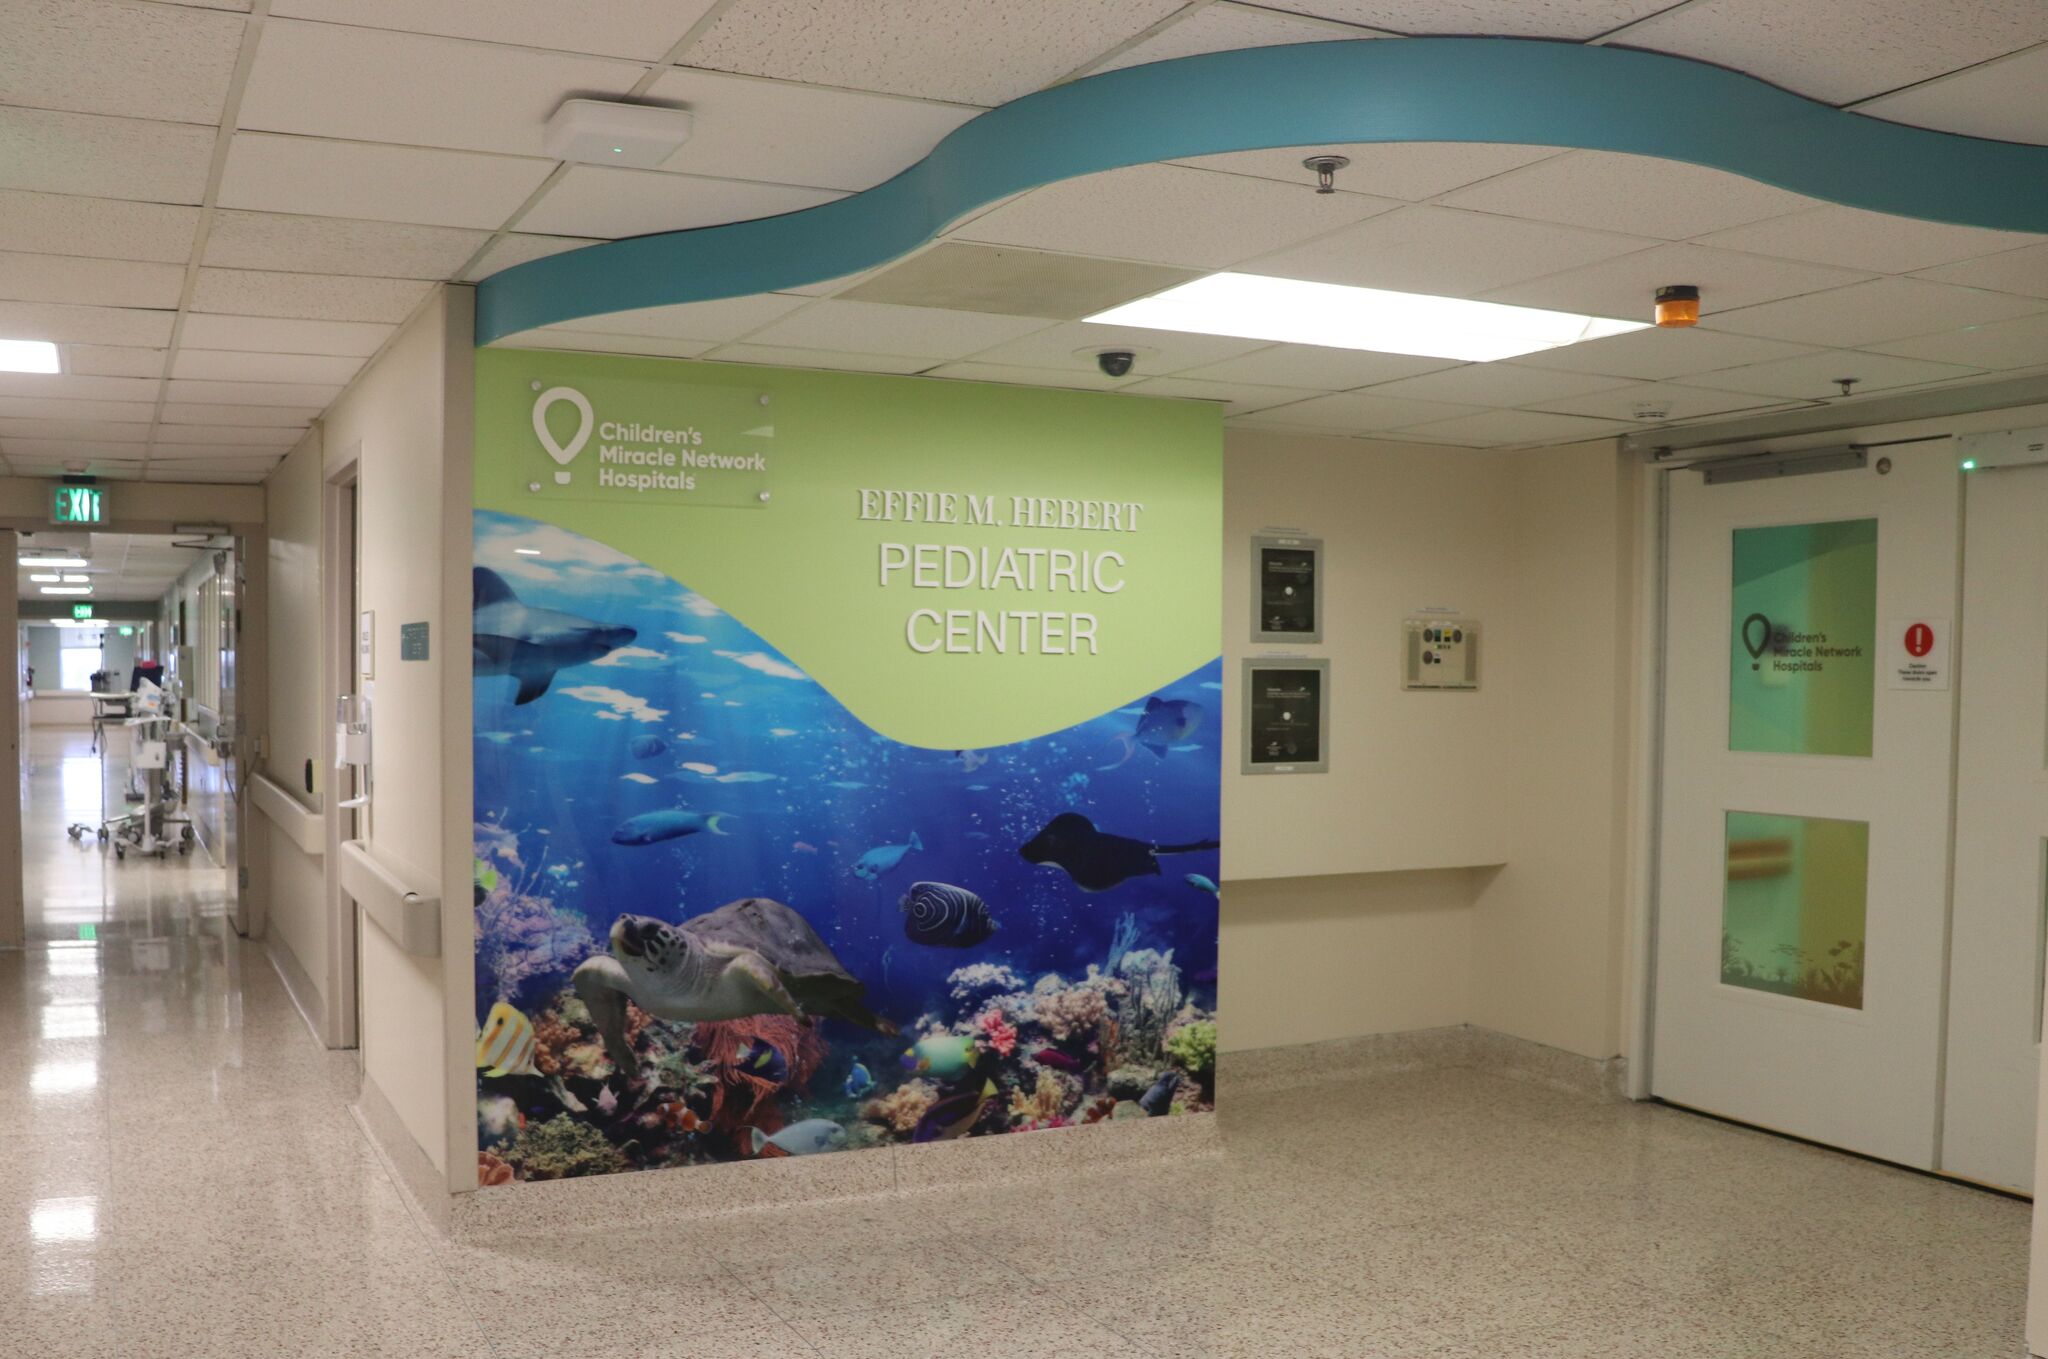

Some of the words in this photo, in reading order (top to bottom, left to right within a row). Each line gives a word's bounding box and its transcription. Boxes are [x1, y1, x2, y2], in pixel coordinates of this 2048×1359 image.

[600, 422, 703, 446] Children's
[599, 446, 676, 467] Miracle
[681, 450, 766, 471] Network
[599, 468, 696, 492] Hospitals
[55, 488, 103, 522] EXIT
[857, 488, 958, 524] EFFIE
[963, 494, 1003, 527] M.
[1010, 496, 1144, 532] HEBERT
[879, 542, 1126, 594] PEDIATRIC
[905, 608, 1099, 656] CENTER
[1816, 646, 1863, 657] Network
[1773, 660, 1823, 673] Hospitals
